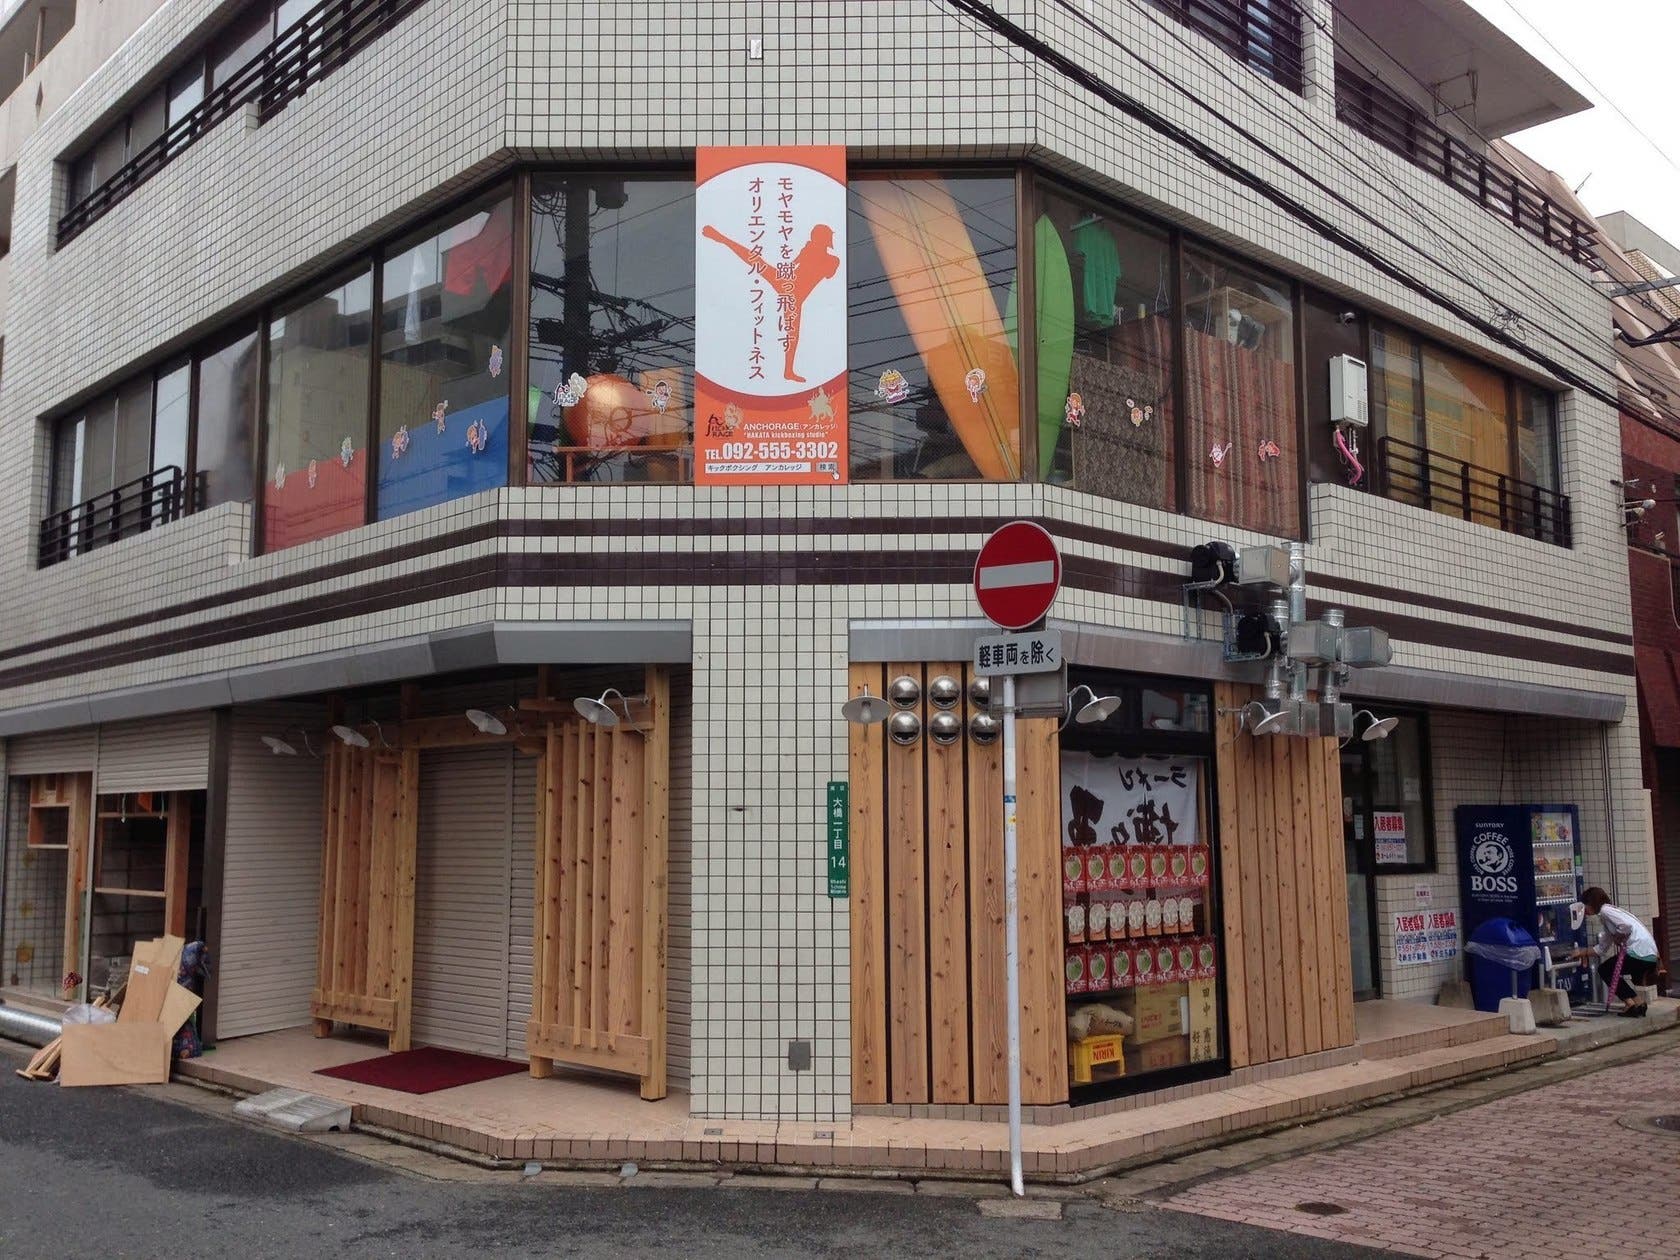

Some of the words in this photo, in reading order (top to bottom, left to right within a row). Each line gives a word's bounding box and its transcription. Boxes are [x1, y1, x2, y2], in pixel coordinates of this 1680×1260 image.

[776, 177, 796, 352] モヤモヤを蹴っ飛ばす
[747, 177, 766, 380] オリエンタル・フィットネス
[979, 640, 1054, 669] 軽車両を除く
[832, 797, 843, 850] 大橋一丁目
[1374, 814, 1405, 832] 入居者募集
[1473, 832, 1509, 846] COFFEE
[831, 856, 846, 868] 14
[1471, 876, 1518, 892] BOSS
[1396, 914, 1425, 932] 入居者募集
[1092, 1047, 1115, 1061] KIRIN
